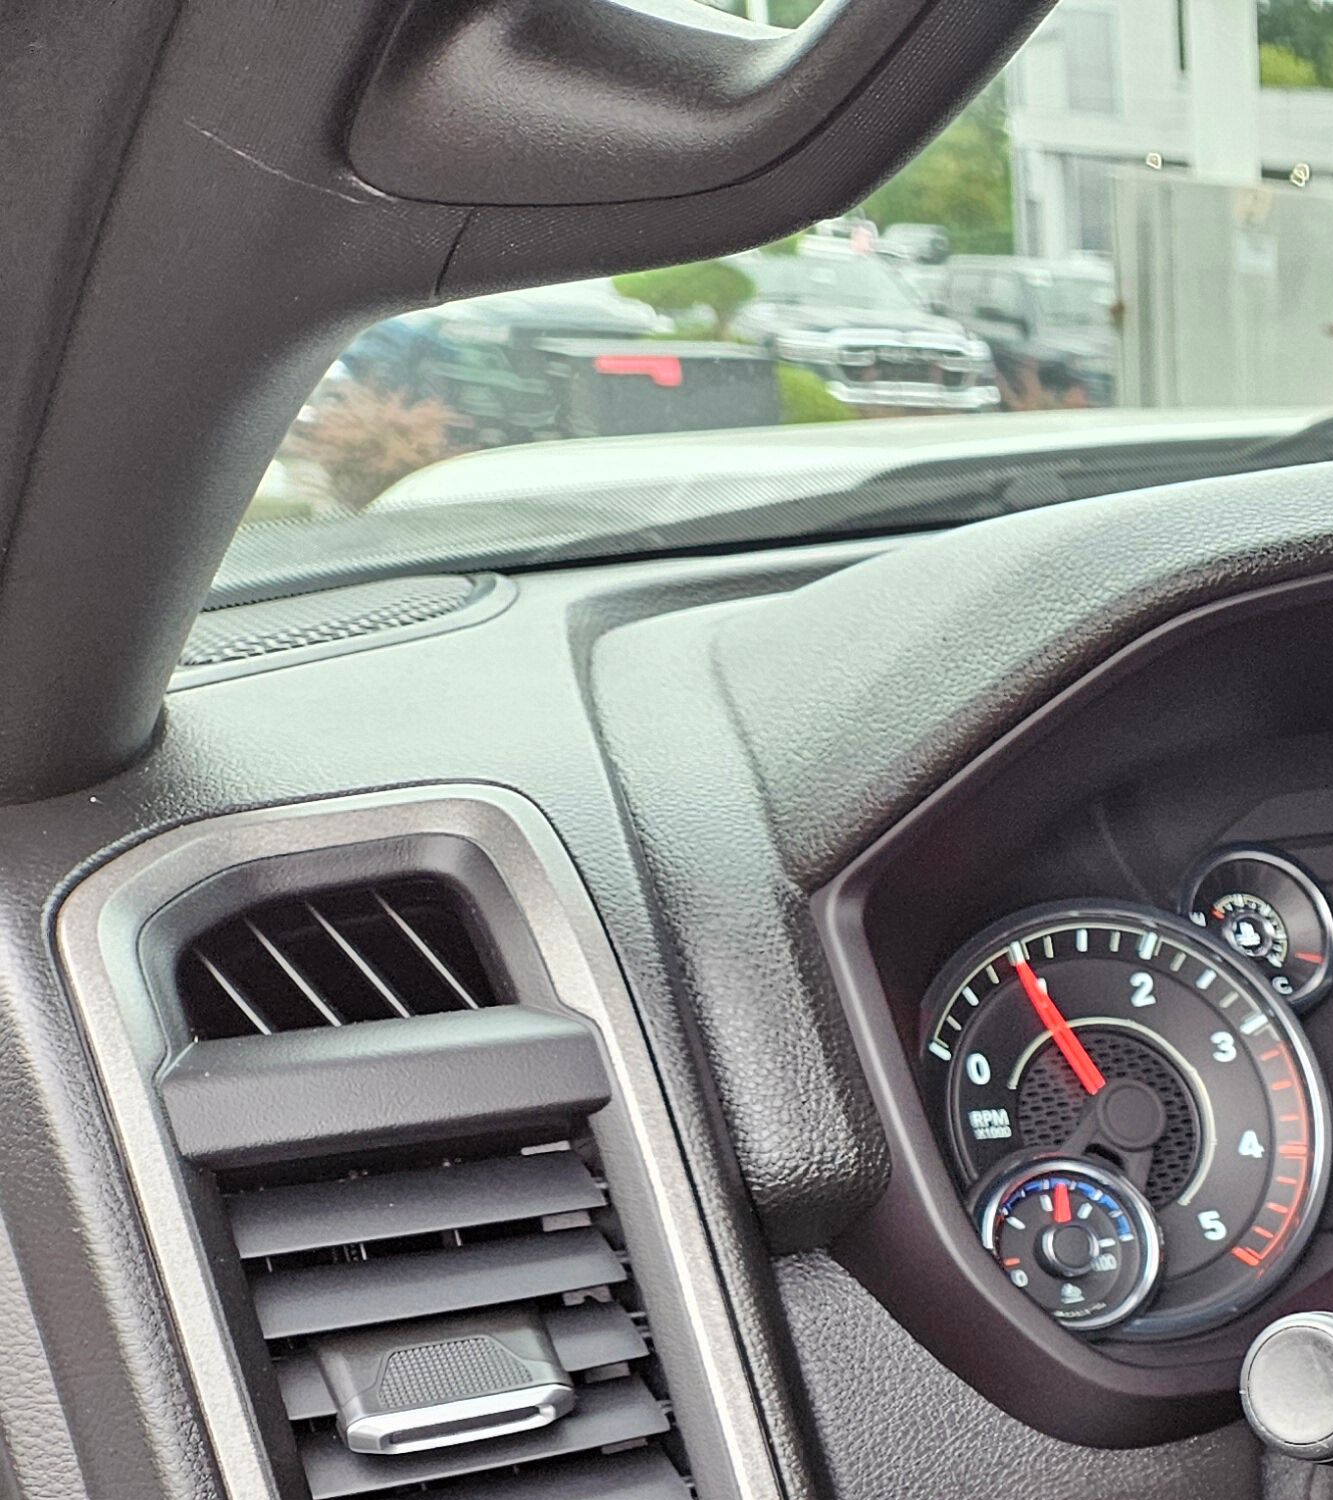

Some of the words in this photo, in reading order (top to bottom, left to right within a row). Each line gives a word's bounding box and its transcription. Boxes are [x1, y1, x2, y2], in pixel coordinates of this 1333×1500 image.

[1129, 972, 1157, 1008] 2
[1210, 1031, 1237, 1063] 3
[966, 1052, 991, 1086] 0
[968, 1108, 1011, 1129] RPM
[1238, 1129, 1265, 1159] 4
[1198, 1210, 1227, 1241] 5
